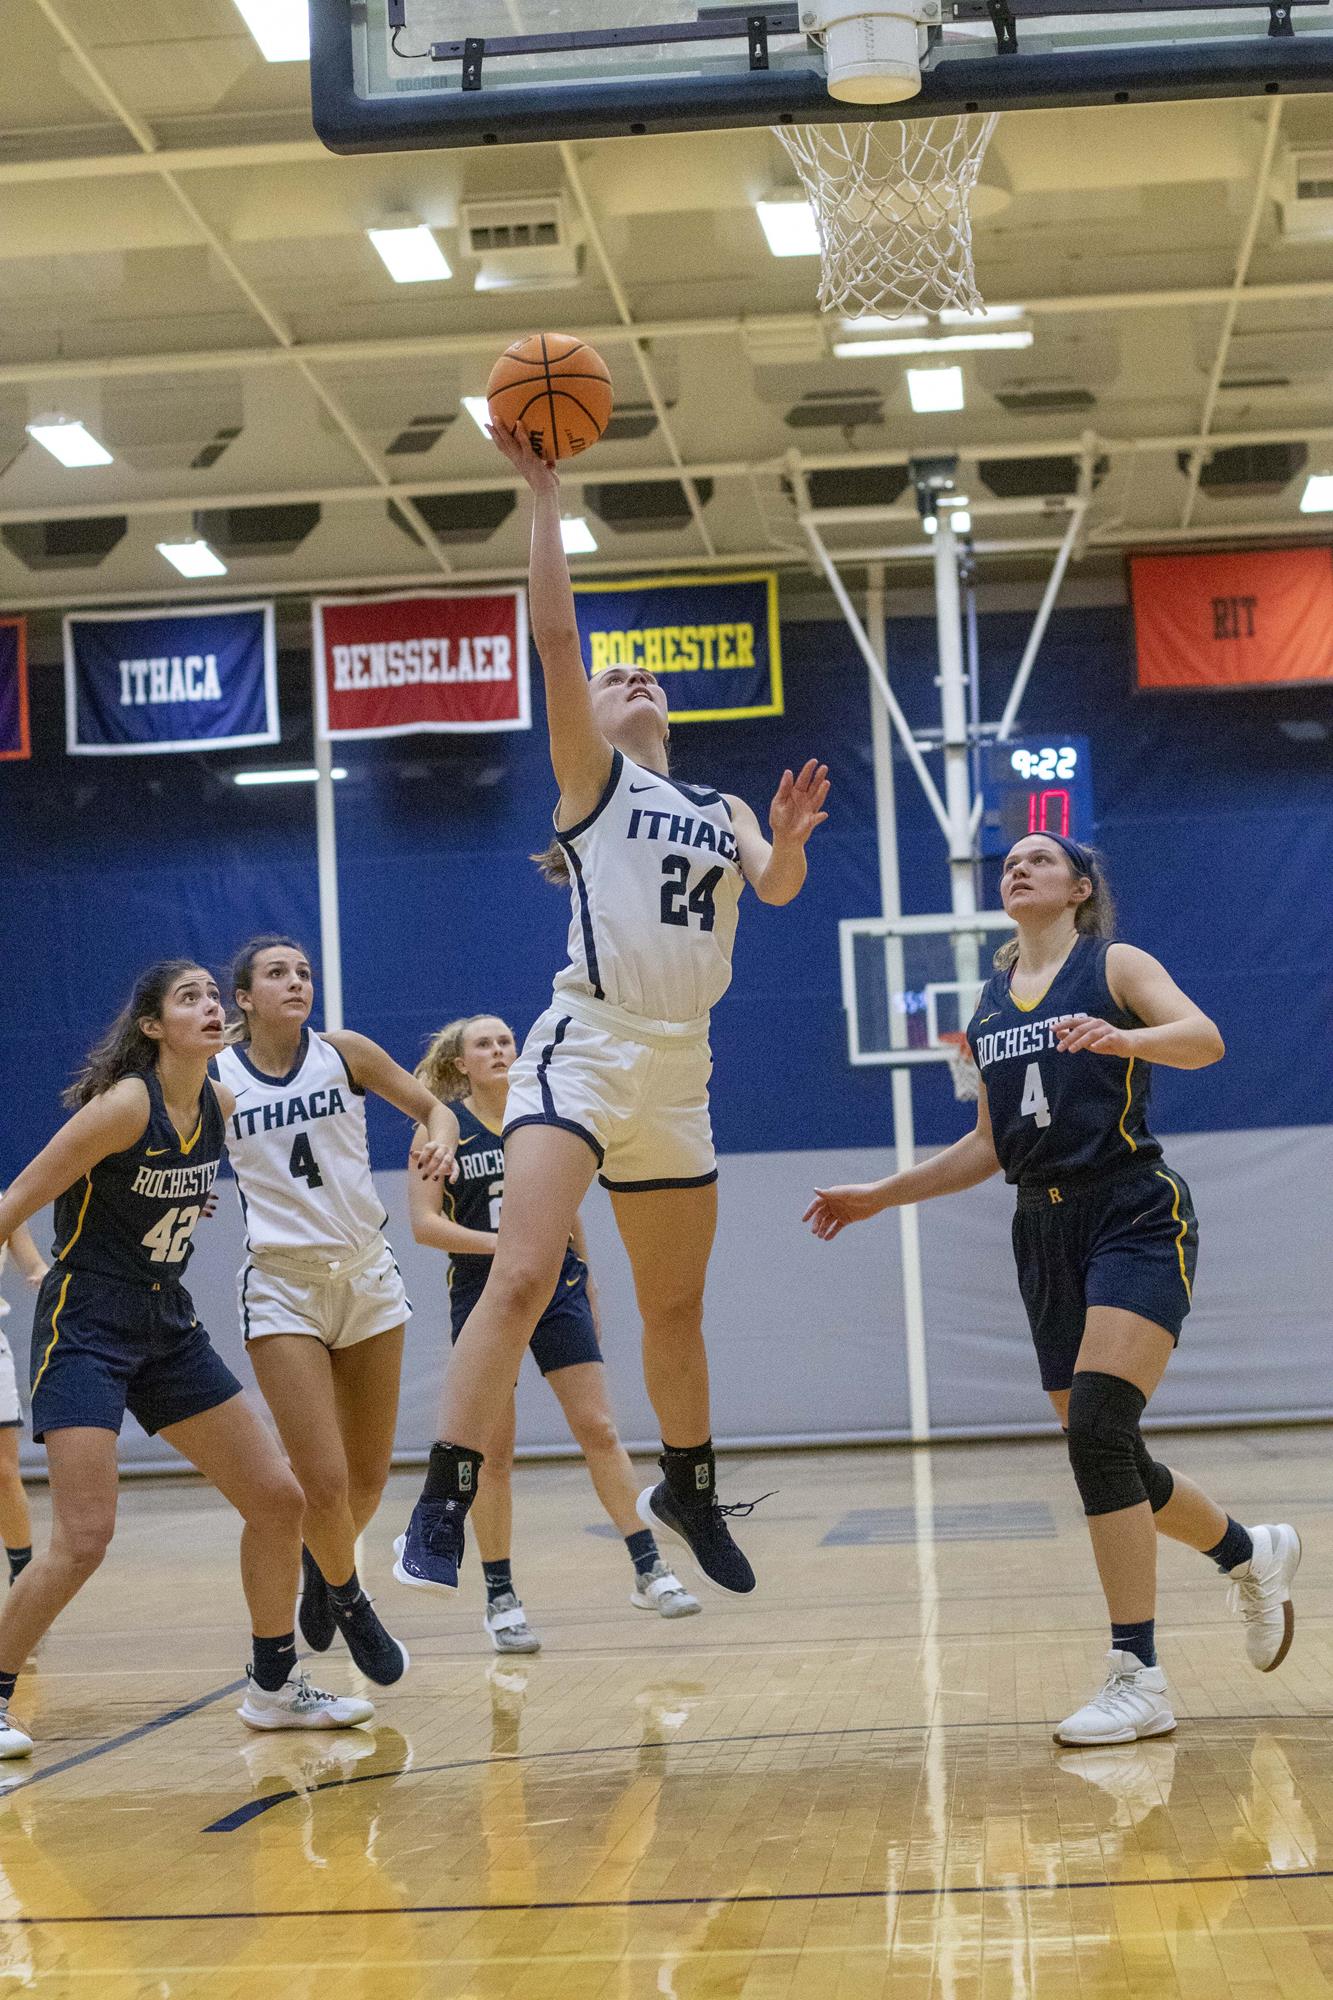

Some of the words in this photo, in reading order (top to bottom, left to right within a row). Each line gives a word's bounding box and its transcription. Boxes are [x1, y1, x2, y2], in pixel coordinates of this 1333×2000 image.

[1211, 596, 1257, 640] RIT
[332, 634, 512, 692] RENSSELAER
[589, 622, 756, 677] ROCHESTER
[119, 654, 222, 706] ITHACA
[1011, 747, 1077, 780] 9:22
[627, 808, 740, 863] ITHAC
[660, 853, 725, 932] 24
[976, 1012, 1089, 1070] ROCHEST
[232, 1088, 346, 1140] ITHACA
[1020, 1062, 1052, 1129] 4
[289, 1132, 324, 1189] 4
[1048, 1187, 1063, 1204] R
[141, 1205, 200, 1263] 42
